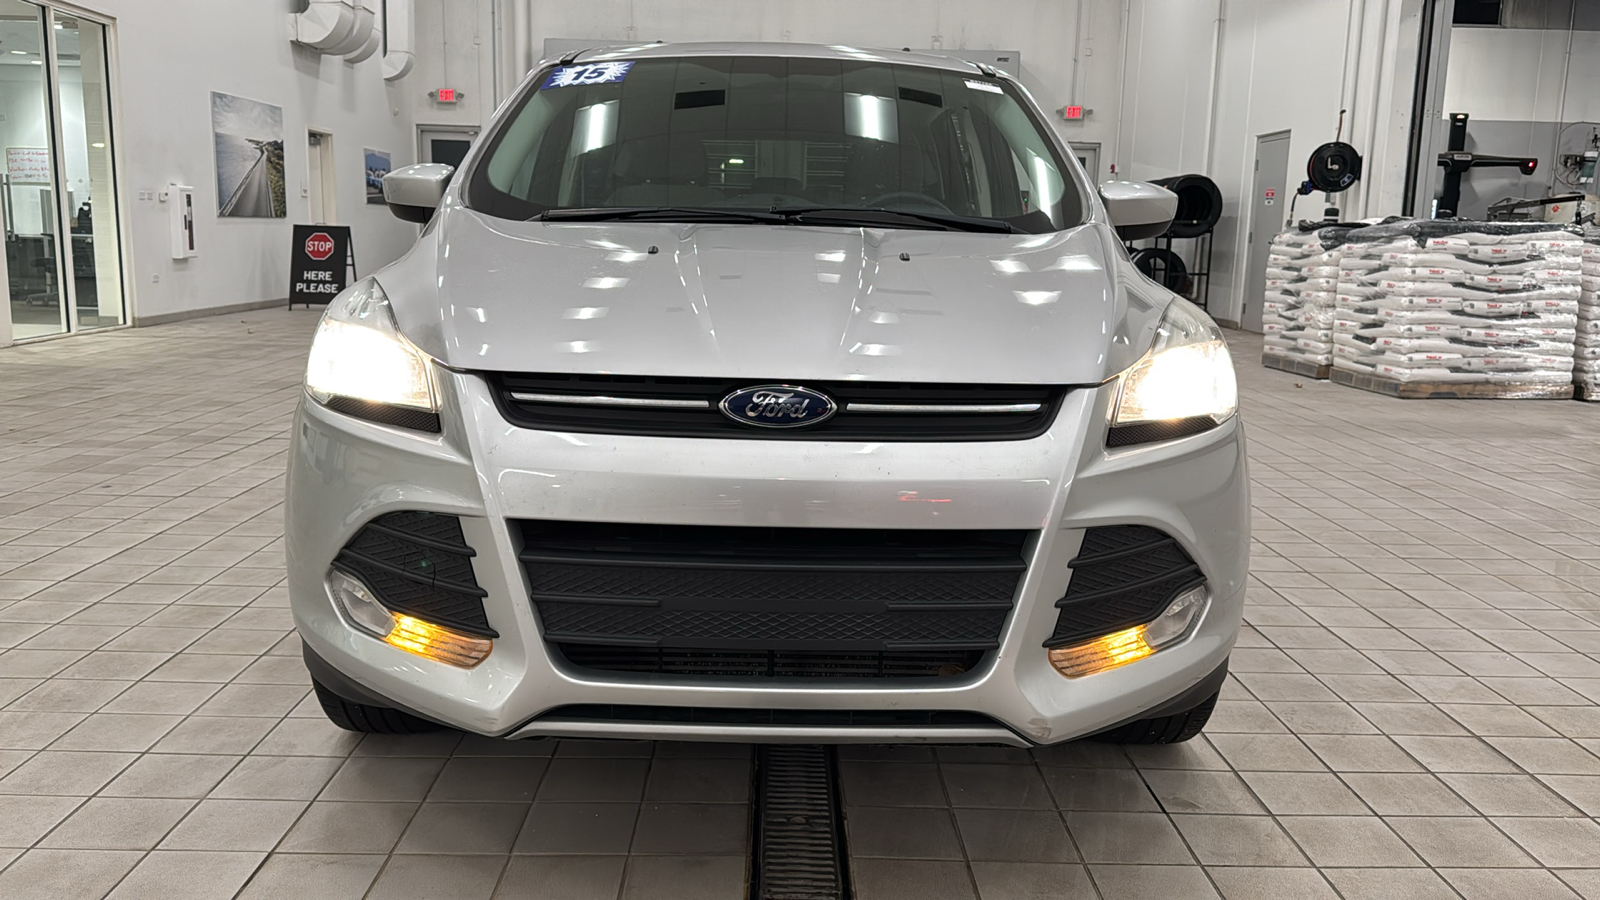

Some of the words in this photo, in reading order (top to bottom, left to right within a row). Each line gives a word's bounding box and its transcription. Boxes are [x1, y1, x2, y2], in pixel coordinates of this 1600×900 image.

[571, 67, 610, 81] 15
[307, 241, 332, 252] STOP
[303, 270, 333, 281] HERE
[295, 282, 339, 294] PLEASE
[745, 390, 810, 418] Ford
